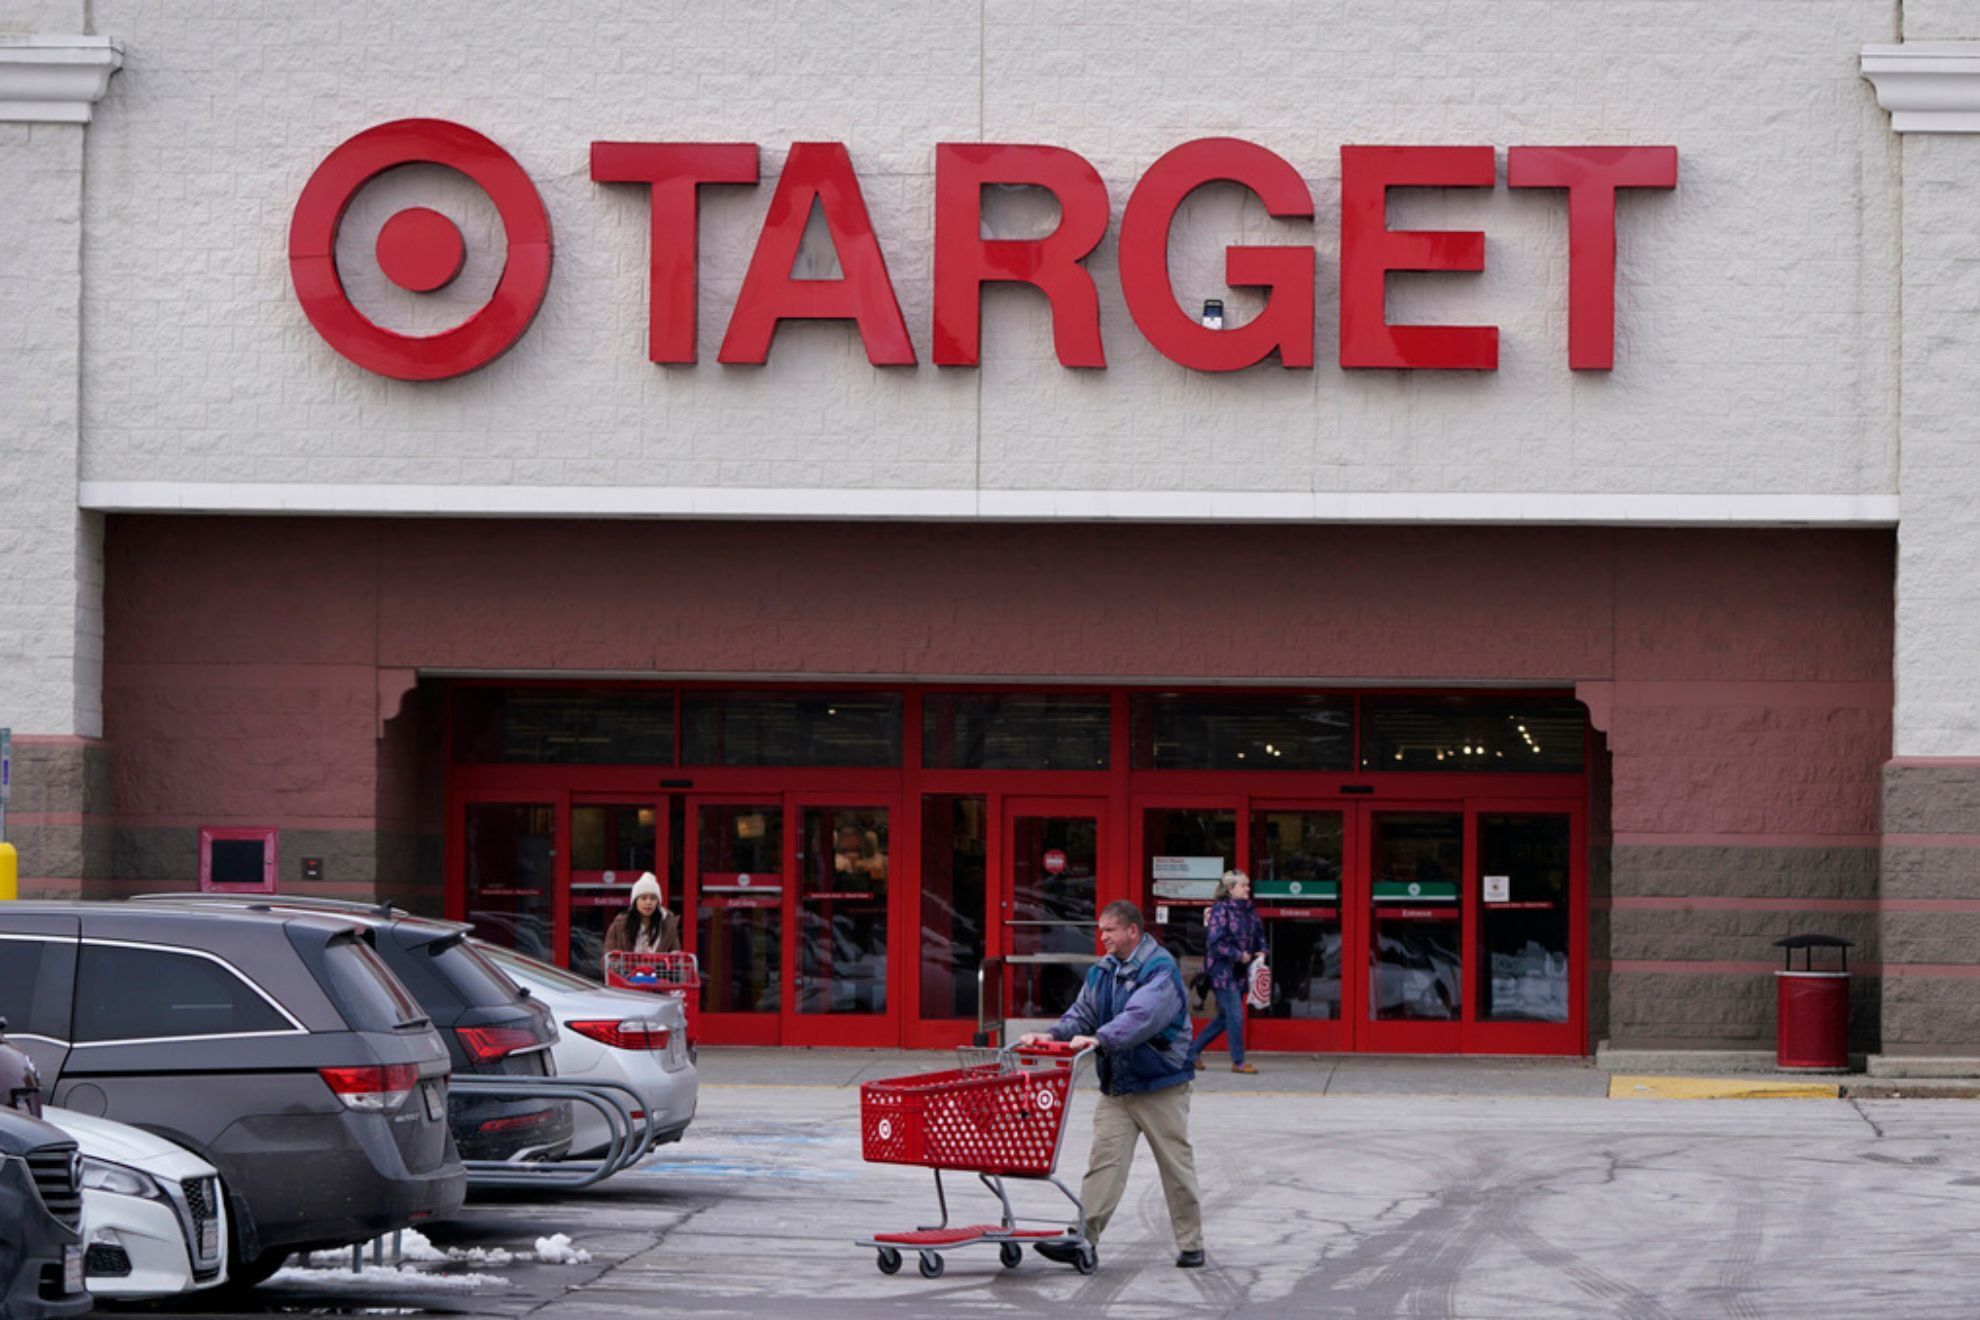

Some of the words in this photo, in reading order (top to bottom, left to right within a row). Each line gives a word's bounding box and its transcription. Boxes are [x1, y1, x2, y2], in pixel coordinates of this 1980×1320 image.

[590, 137, 1677, 372] TARGET
[1280, 908, 1310, 916] Entrance
[1402, 909, 1432, 917] Entrance
